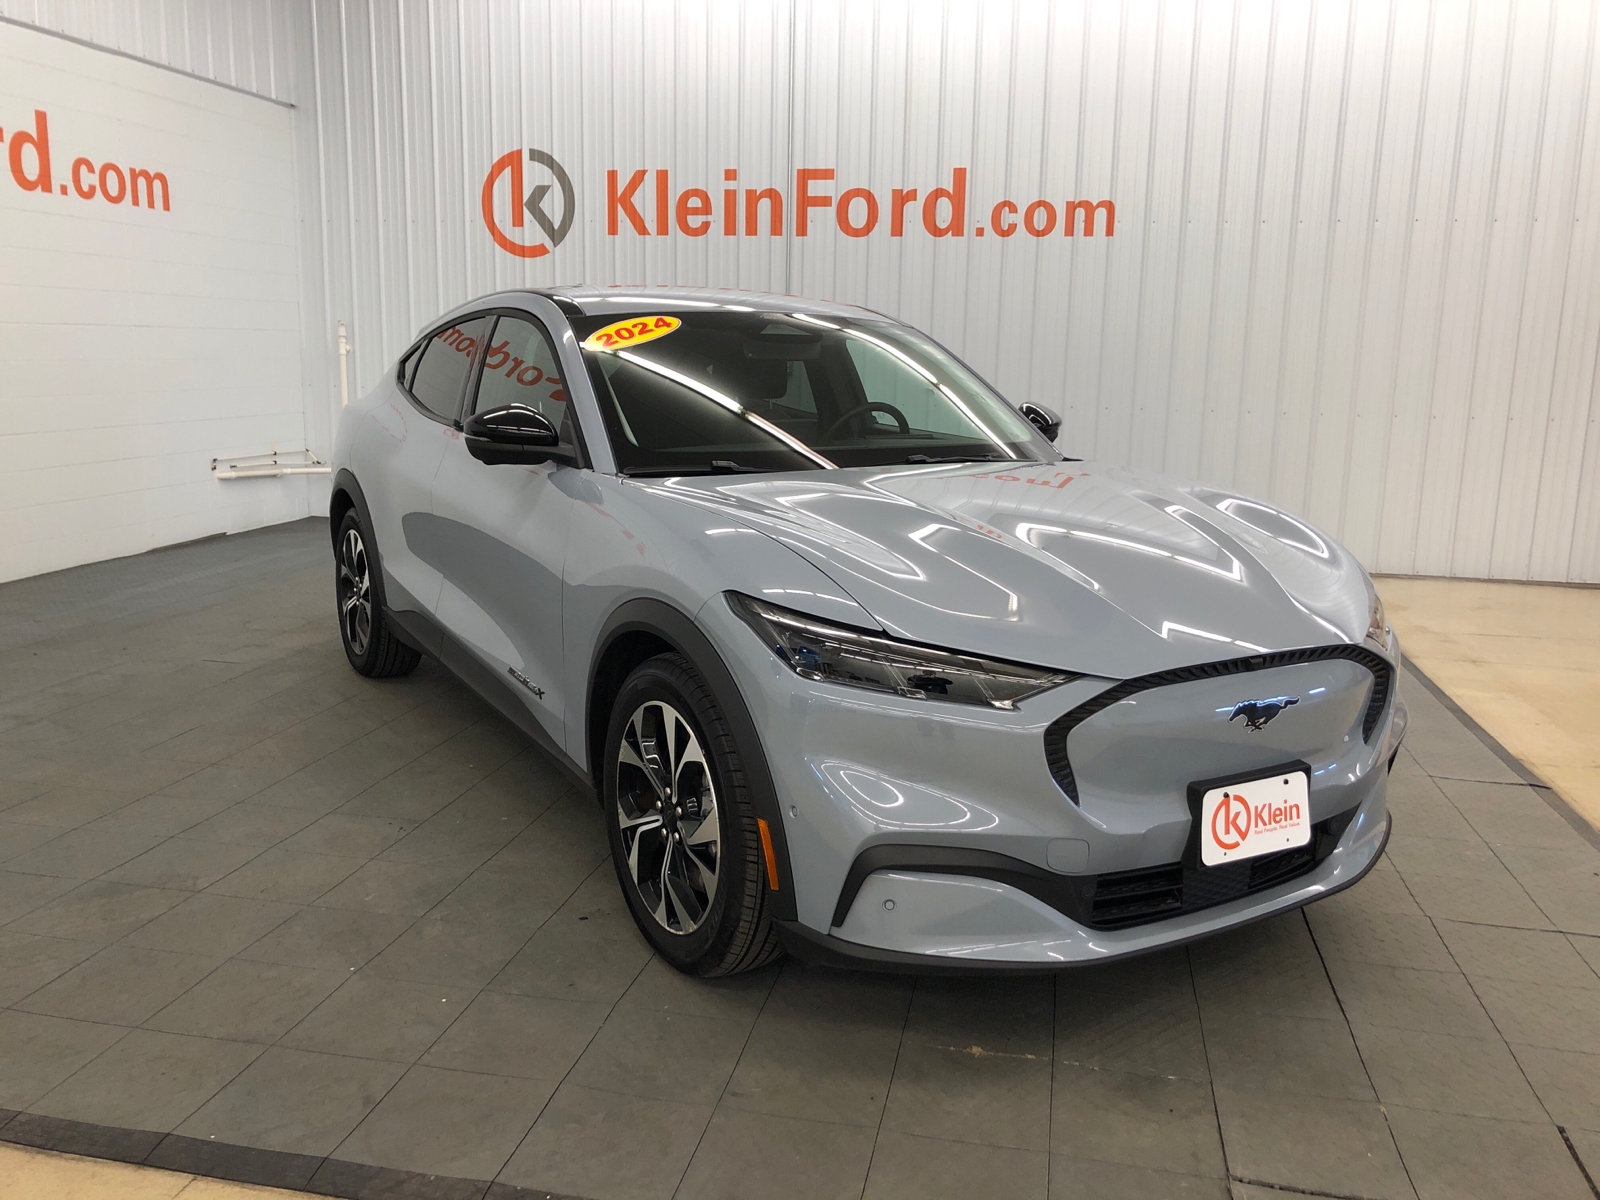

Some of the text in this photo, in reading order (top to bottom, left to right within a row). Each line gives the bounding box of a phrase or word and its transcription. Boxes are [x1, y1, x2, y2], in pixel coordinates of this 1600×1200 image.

[0, 109, 171, 212] d.com
[606, 167, 1116, 238] KleinFord.com
[596, 317, 673, 348] 2024
[1254, 799, 1300, 828] Klein
